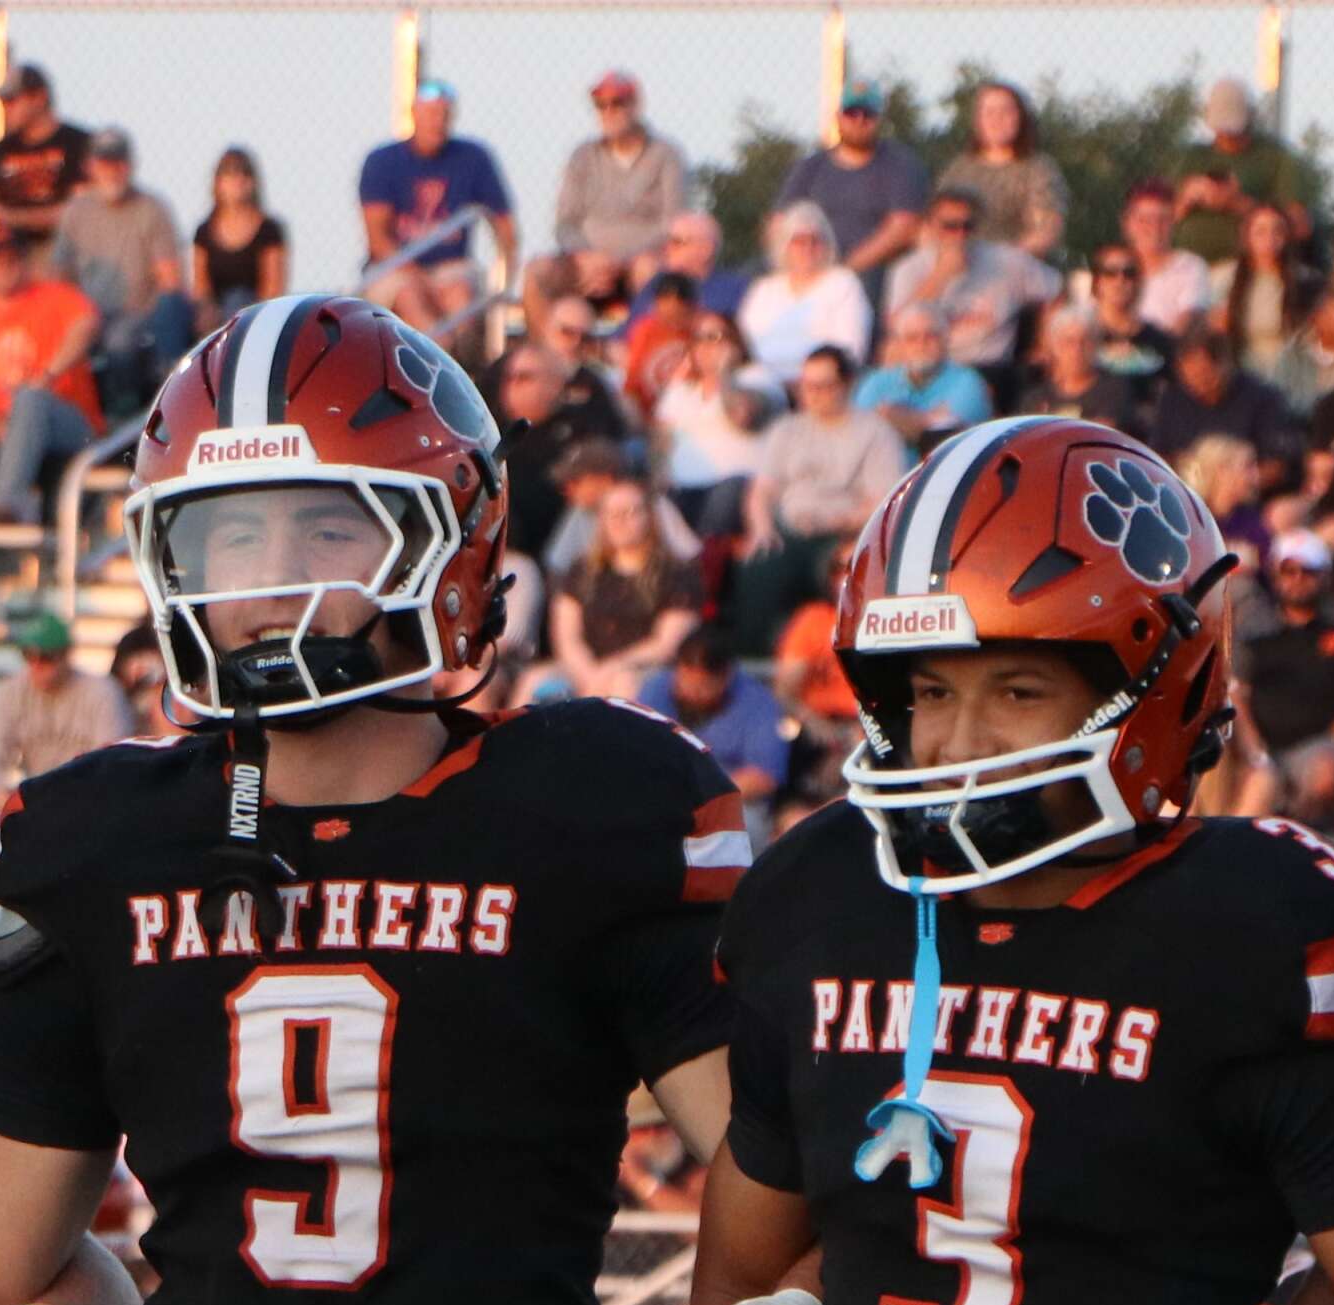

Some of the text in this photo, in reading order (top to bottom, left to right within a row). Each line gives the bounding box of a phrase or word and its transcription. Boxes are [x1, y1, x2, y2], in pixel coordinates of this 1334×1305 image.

[197, 434, 300, 466] Riddell
[865, 607, 957, 636] Riddell
[256, 654, 294, 670] Ridde
[228, 762, 262, 841] NXTRND
[126, 879, 518, 967] PANTHERS
[810, 978, 1161, 1083] PANTHERS
[225, 962, 400, 1291] 9
